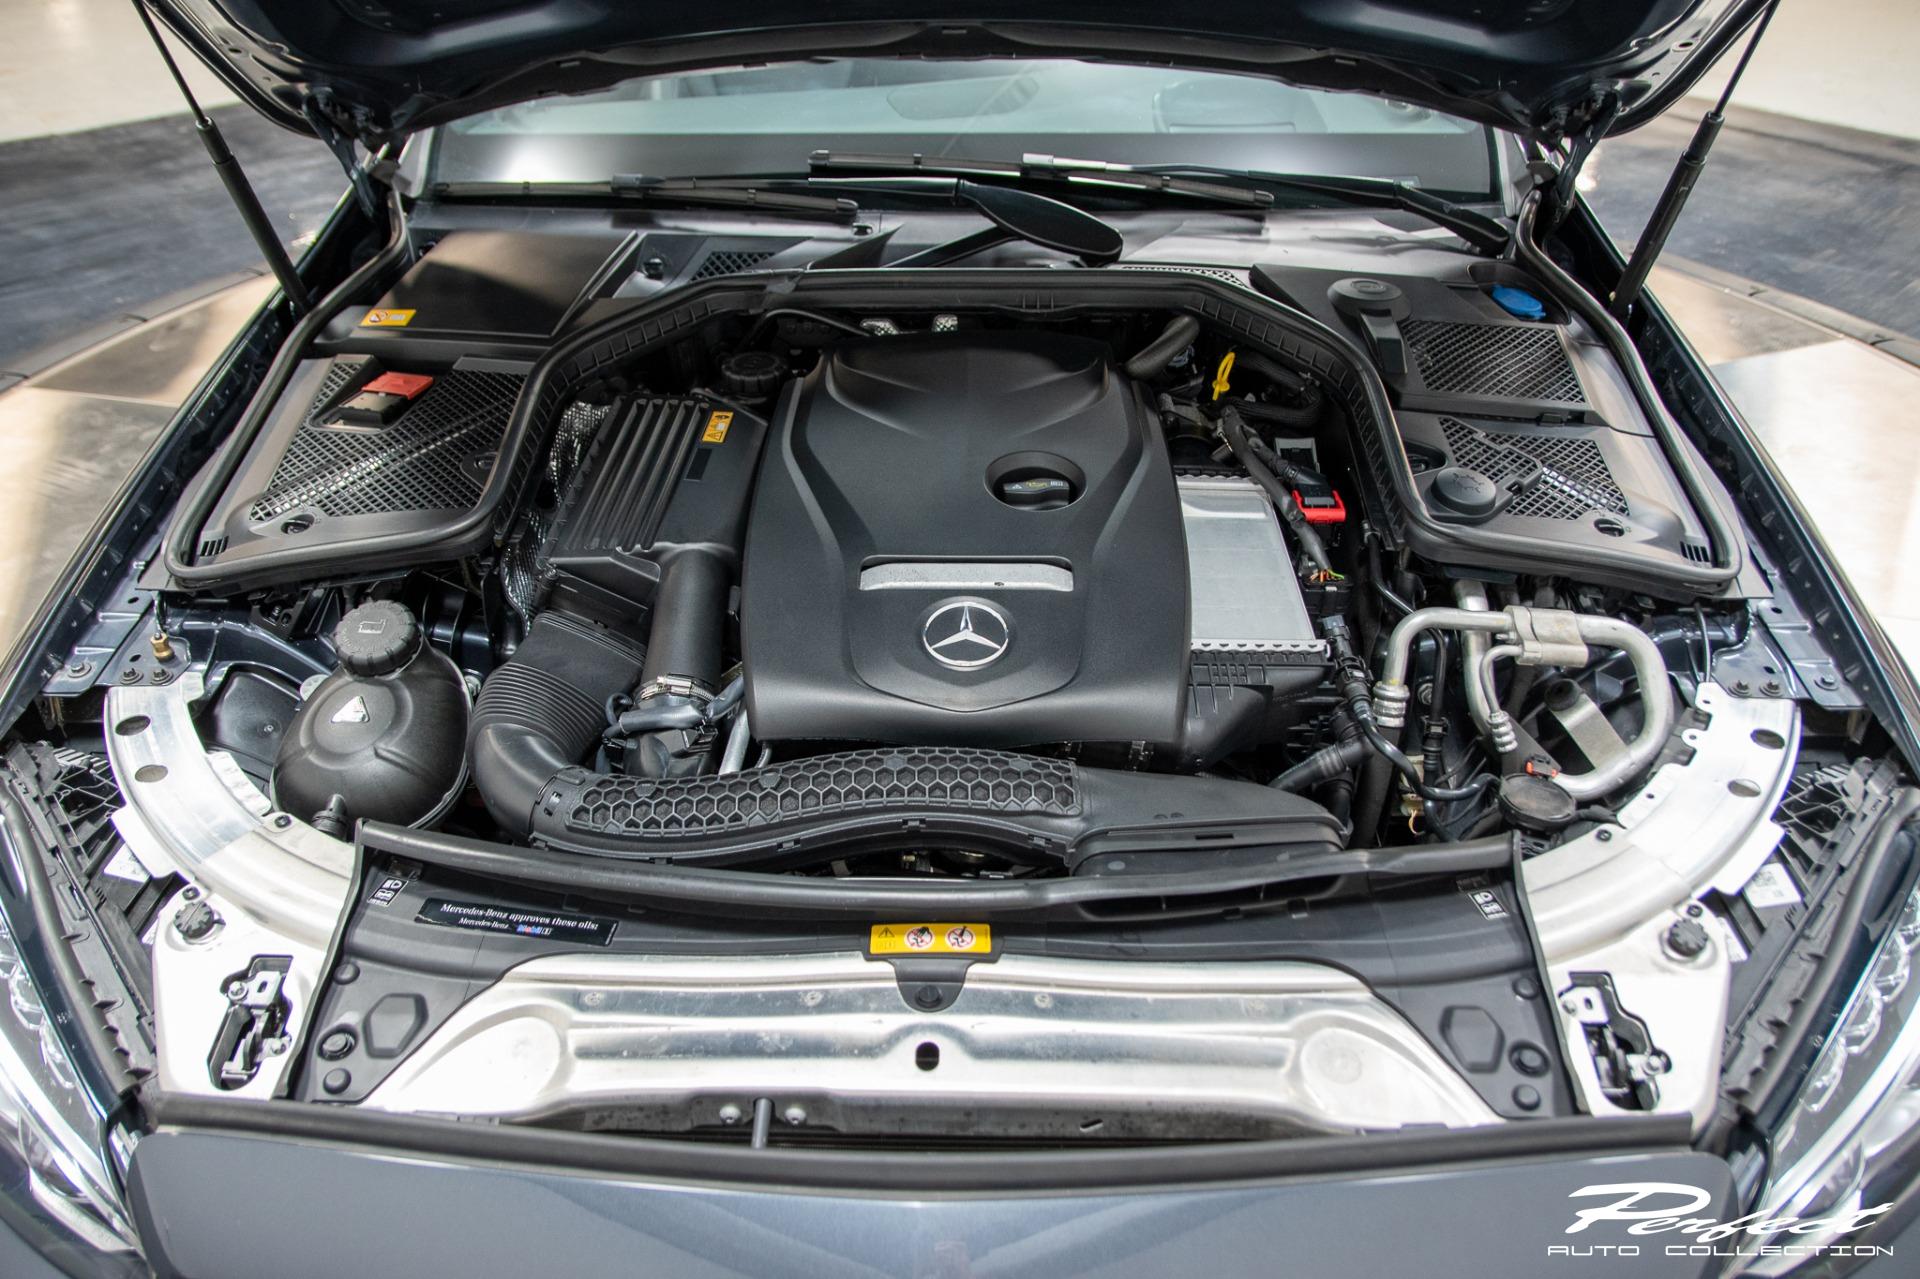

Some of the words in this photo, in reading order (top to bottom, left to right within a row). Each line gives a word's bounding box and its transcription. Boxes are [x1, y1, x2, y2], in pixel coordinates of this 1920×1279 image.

[440, 903, 509, 919] Mercedes-Benz
[509, 912, 551, 924] approves
[552, 917, 577, 927] these
[459, 917, 509, 929] Mercedes-Benz
